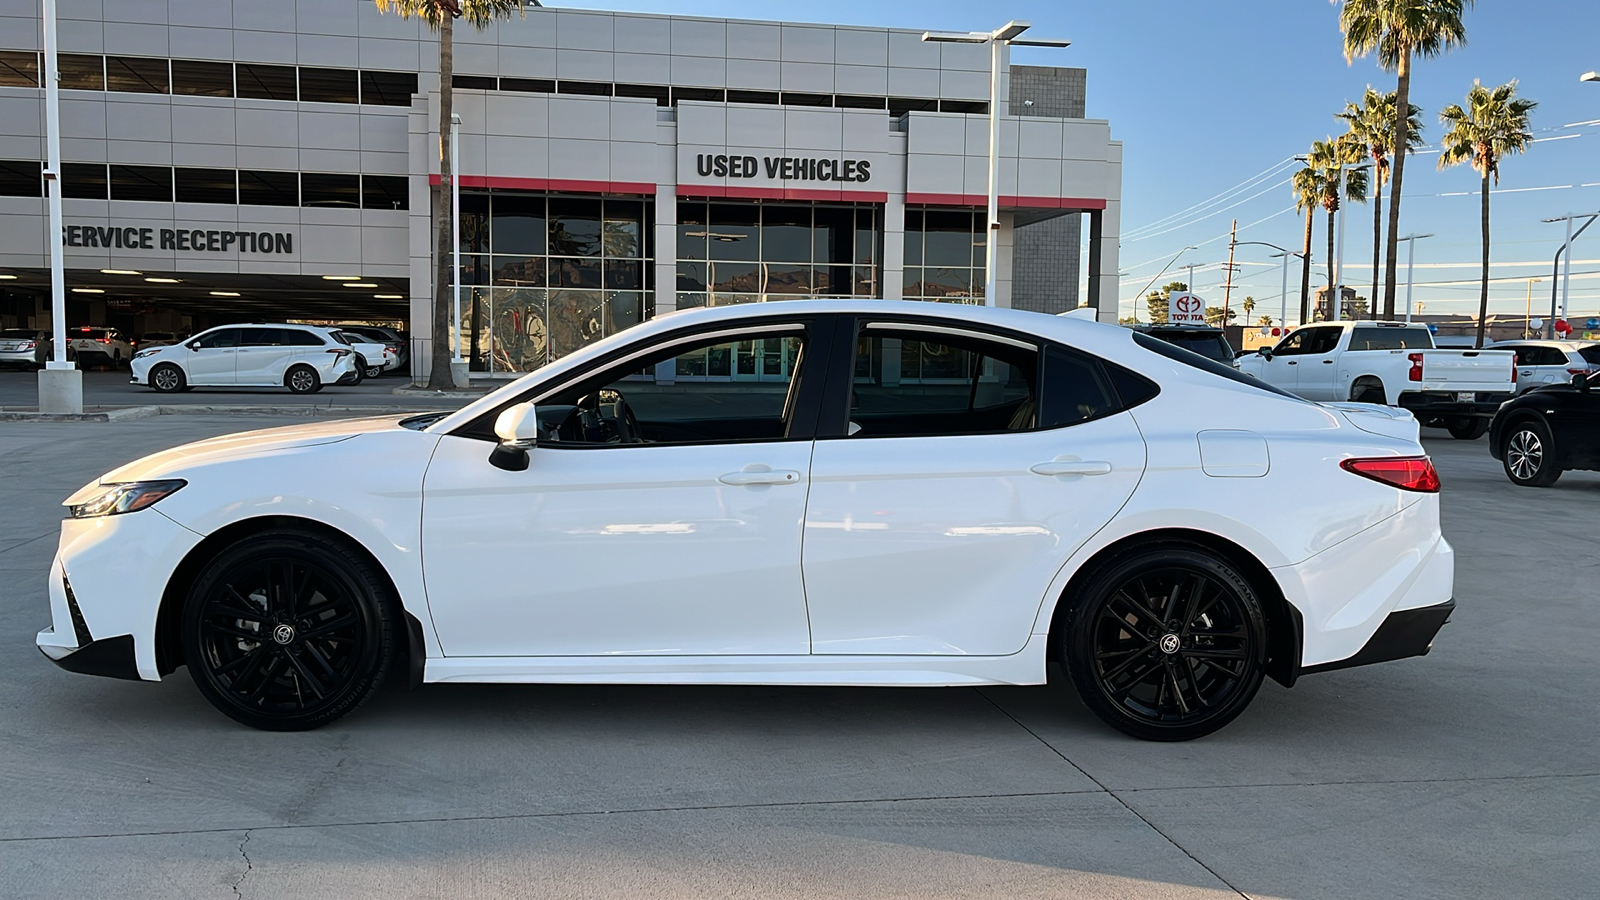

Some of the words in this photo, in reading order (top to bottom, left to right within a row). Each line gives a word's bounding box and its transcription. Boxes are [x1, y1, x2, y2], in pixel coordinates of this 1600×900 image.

[697, 154, 758, 178] USED
[764, 157, 871, 182] VEHICLES
[159, 228, 293, 254] RECEPTION
[1216, 563, 1261, 618] TURANZA
